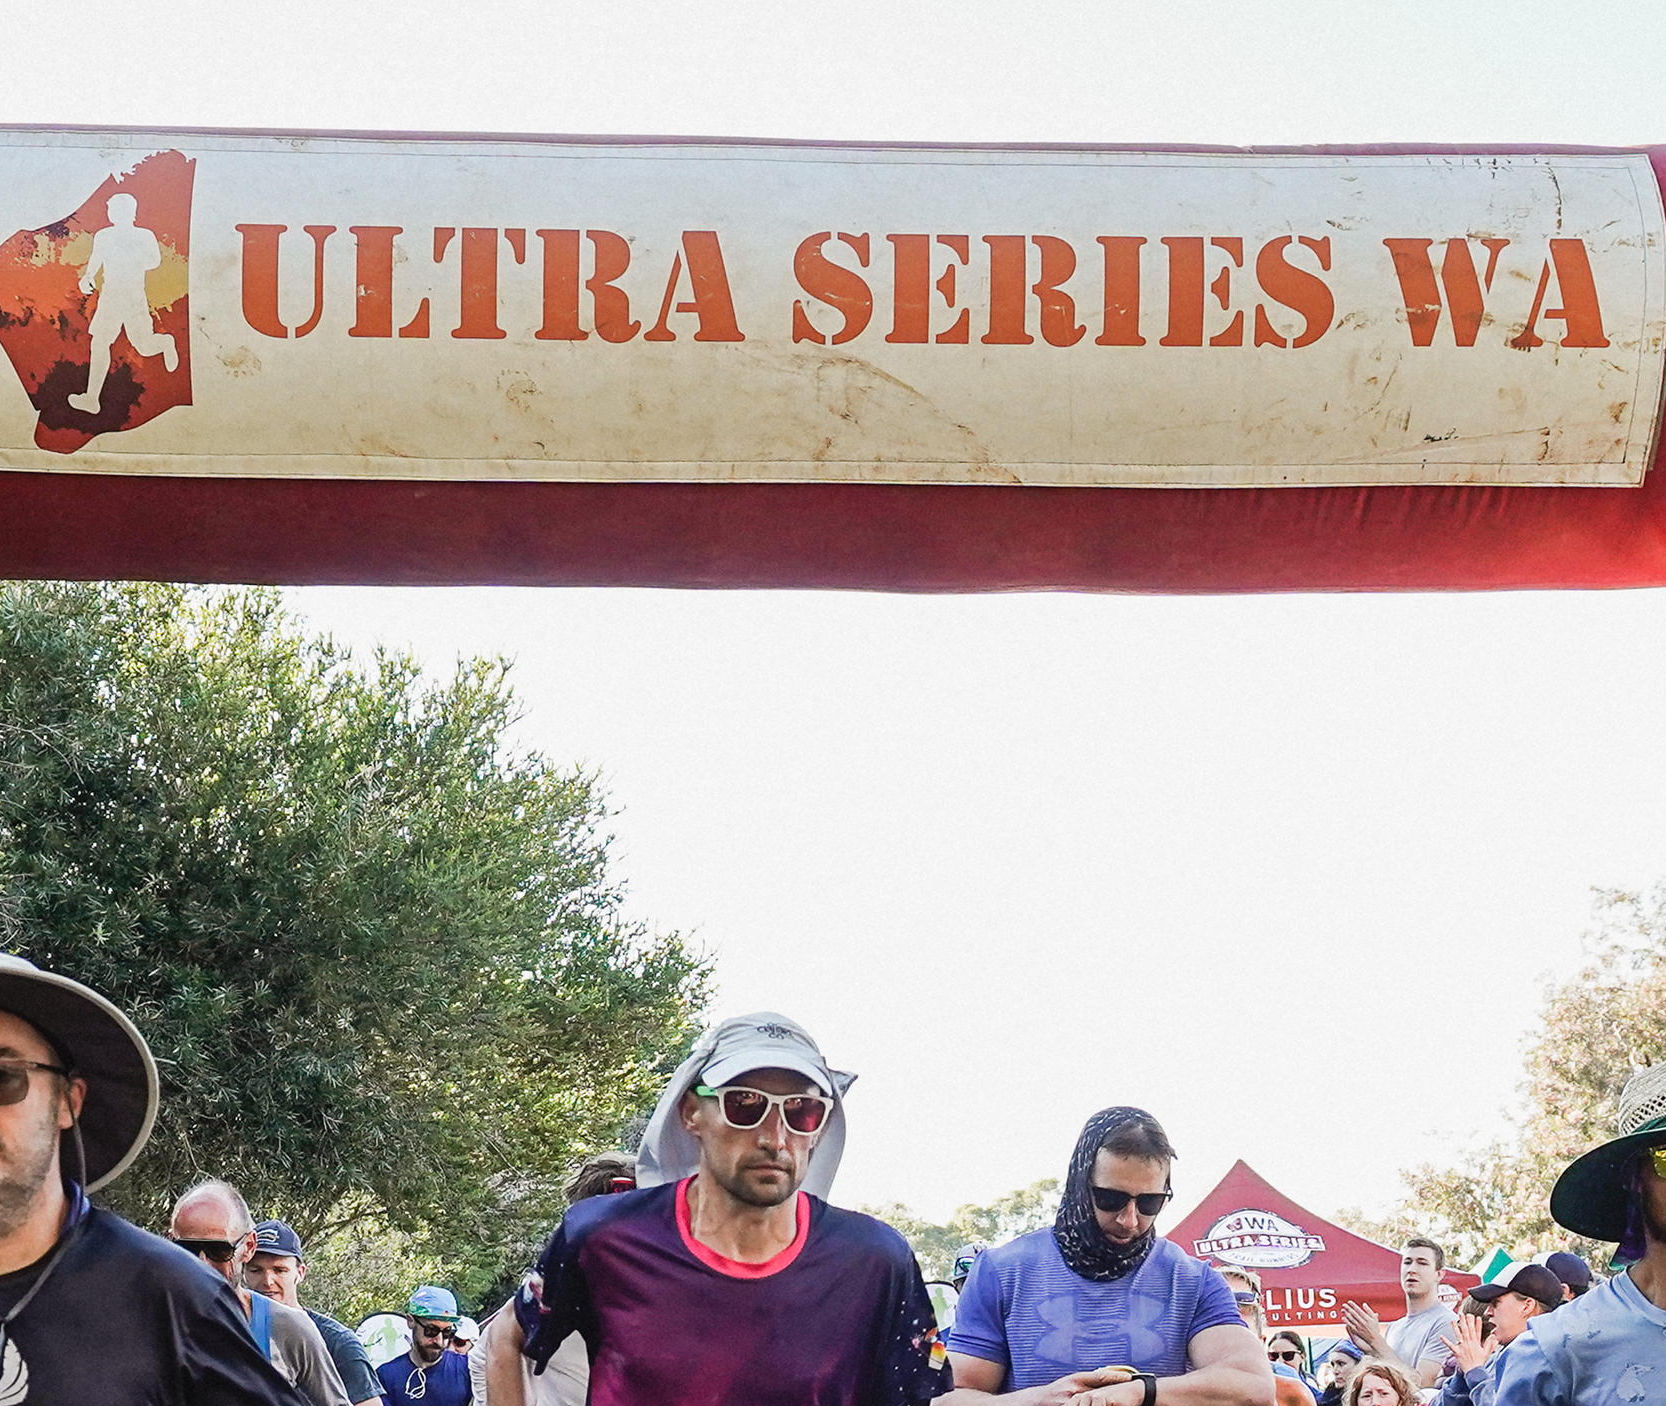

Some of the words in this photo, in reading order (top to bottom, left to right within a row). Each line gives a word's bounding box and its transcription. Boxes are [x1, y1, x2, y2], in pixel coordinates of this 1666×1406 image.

[235, 222, 745, 345] ULTRA
[789, 232, 1338, 350] SERIES
[1383, 236, 1611, 351] WA
[1244, 1216, 1279, 1231] WA
[1199, 1235, 1254, 1253] ULTRA
[1259, 1234, 1321, 1248] SERIES
[1263, 1288, 1337, 1311] LIUS
